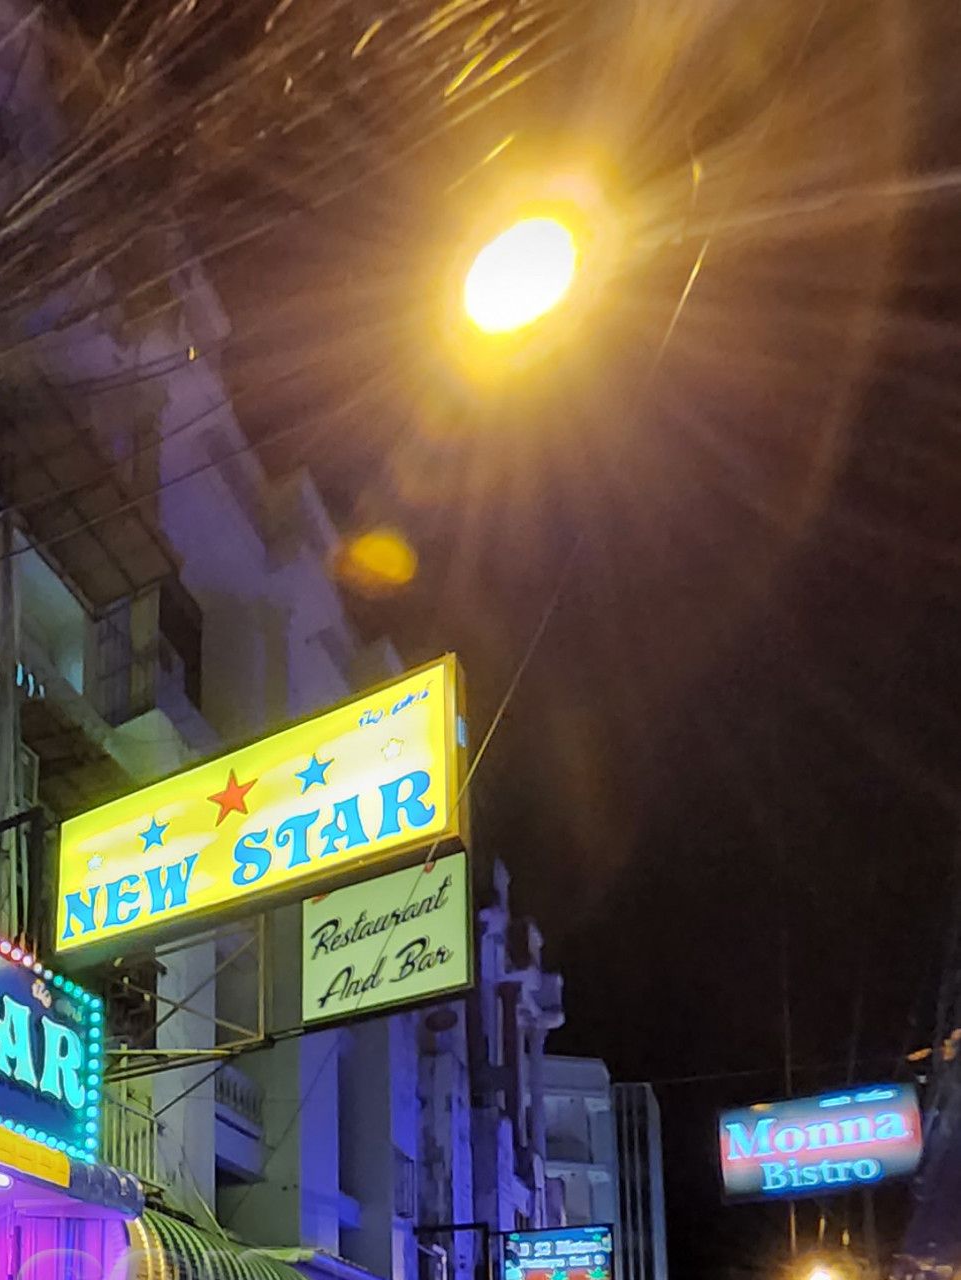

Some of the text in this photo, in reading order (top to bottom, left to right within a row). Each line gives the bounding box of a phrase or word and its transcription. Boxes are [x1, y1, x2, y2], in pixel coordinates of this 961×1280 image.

[61, 768, 437, 940] NEW STAR
[310, 873, 454, 961] Restaurant
[317, 934, 454, 1010] And Bar
[725, 1110, 909, 1160] Monna
[760, 1157, 880, 1190] Bistro
